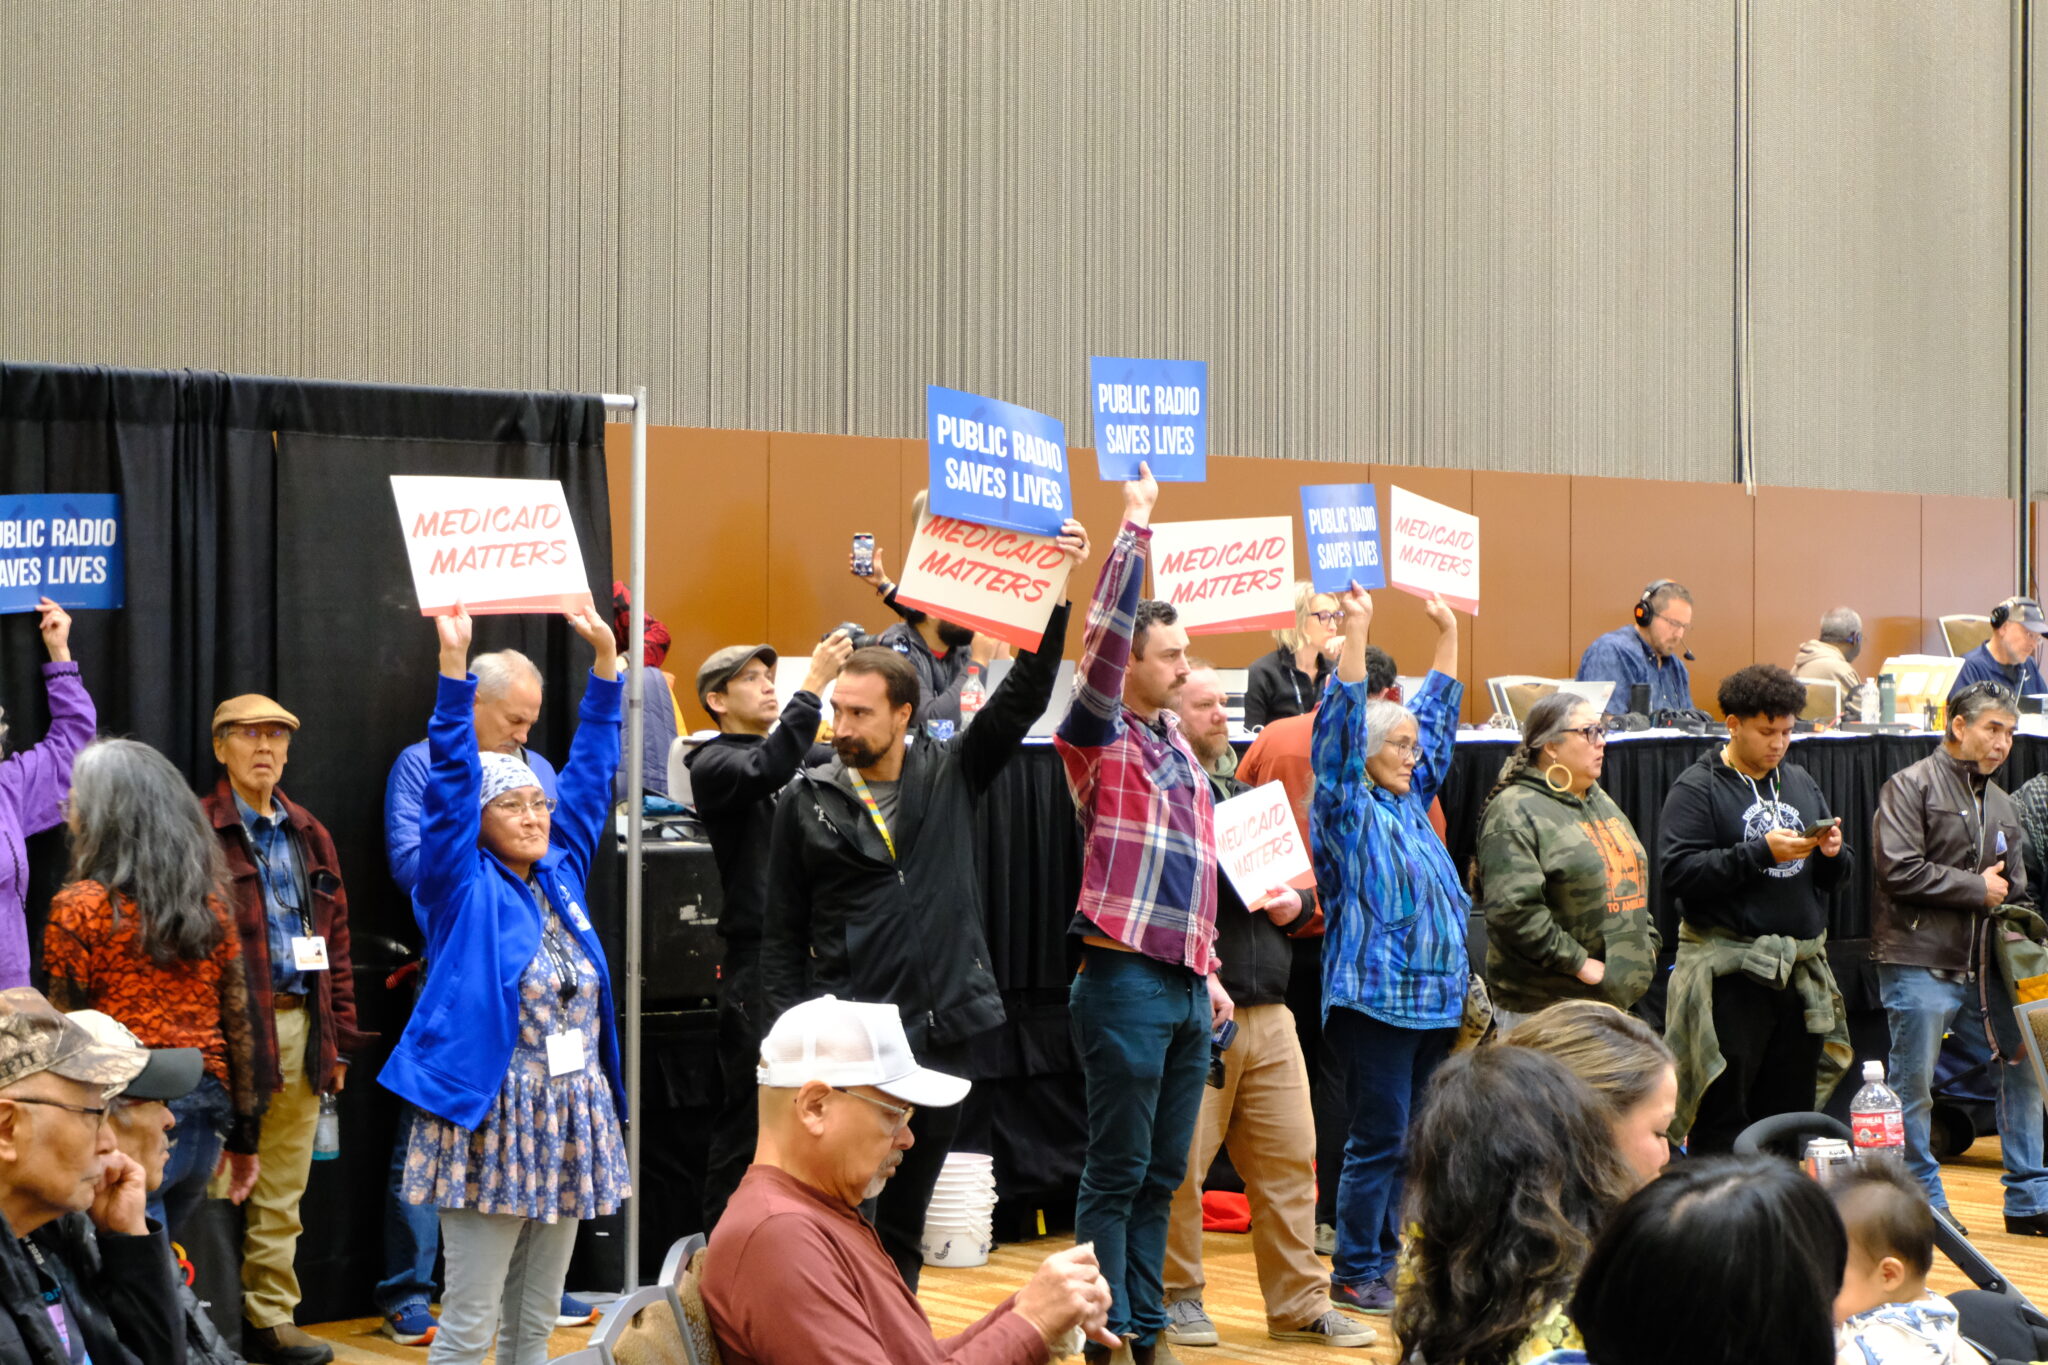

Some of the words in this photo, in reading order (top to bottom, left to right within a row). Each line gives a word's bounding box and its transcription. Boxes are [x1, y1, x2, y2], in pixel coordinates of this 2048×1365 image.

[1098, 383, 1151, 415] PUBLIC
[1154, 385, 1200, 416] RADIO
[937, 413, 1008, 458] PUBLIC
[1012, 430, 1063, 473] RADIO
[1105, 423, 1151, 455] SAVES
[1154, 425, 1195, 456] LIVES
[945, 457, 1007, 499] SAVES
[1012, 471, 1064, 511] LIVES
[0, 518, 45, 549] BLIC
[51, 518, 116, 547] RADIO
[412, 503, 561, 538] MEDICAID
[1308, 507, 1349, 535] PUBLIC
[1348, 505, 1377, 532] RADIO
[1395, 516, 1474, 550] MEDICAID
[429, 539, 567, 576] MATTERS
[921, 515, 1066, 569] MEDICAID
[1160, 536, 1285, 575] MEDICAID
[1317, 542, 1353, 570] SAVES
[1352, 540, 1379, 567] LIVES
[48, 555, 107, 584] LIVES
[918, 550, 1051, 603] MATTERS
[1399, 544, 1473, 577] MATTERS
[1170, 567, 1284, 605] MATTERS
[1217, 803, 1286, 854] MEDICAID
[1234, 831, 1293, 878] MATTERS
[1607, 902, 1620, 913] TO
